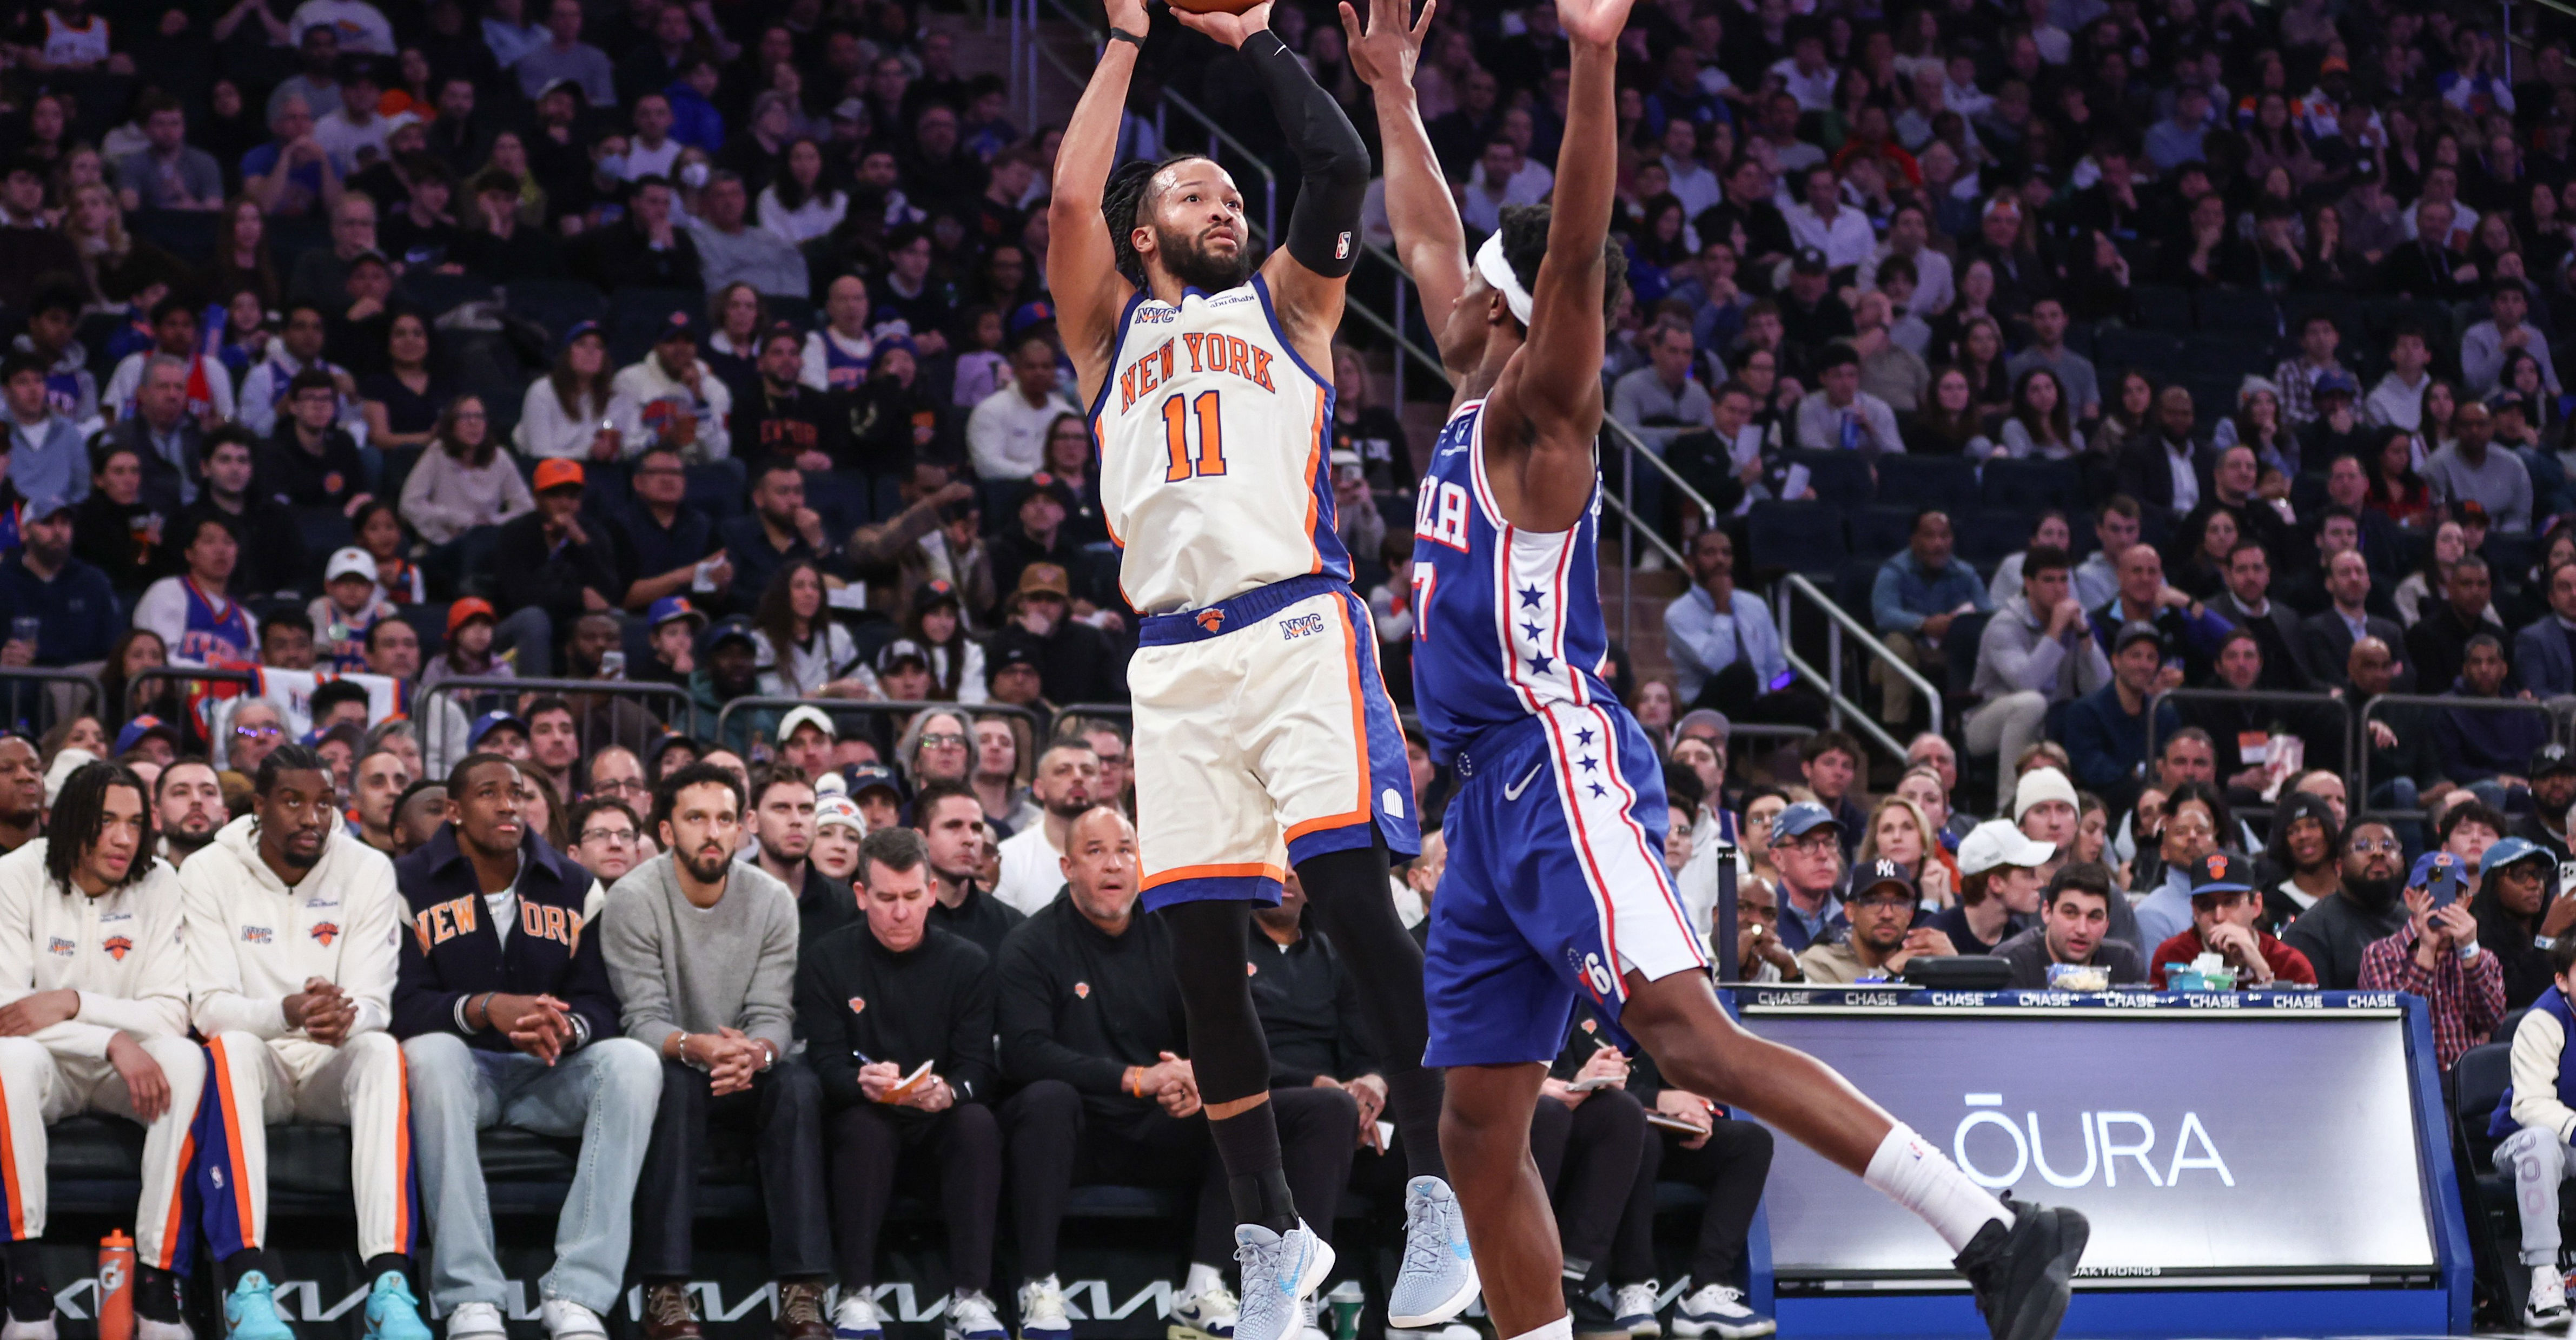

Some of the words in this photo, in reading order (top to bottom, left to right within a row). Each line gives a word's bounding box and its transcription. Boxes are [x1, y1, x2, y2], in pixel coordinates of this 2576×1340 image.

[1229, 294, 1255, 303] dhabi
[1135, 307, 1176, 324] NYC
[1120, 336, 1174, 417] NEW
[1183, 333, 1275, 394] YORK
[1162, 390, 1227, 483] 11
[1412, 562, 1438, 643] 7
[1280, 613, 1323, 639] NYC
[412, 893, 477, 958] NEW
[517, 894, 583, 960] ORK
[1758, 991, 1809, 1005] CHASE
[1845, 992, 1897, 1006] CHASE
[1932, 992, 1984, 1006] CHASE
[2019, 992, 2070, 1006] CHASE
[2105, 993, 2156, 1008] CHASE
[2191, 994, 2240, 1008] CHASE
[2273, 994, 2323, 1009] CHASE
[2348, 994, 2396, 1008] CHASE
